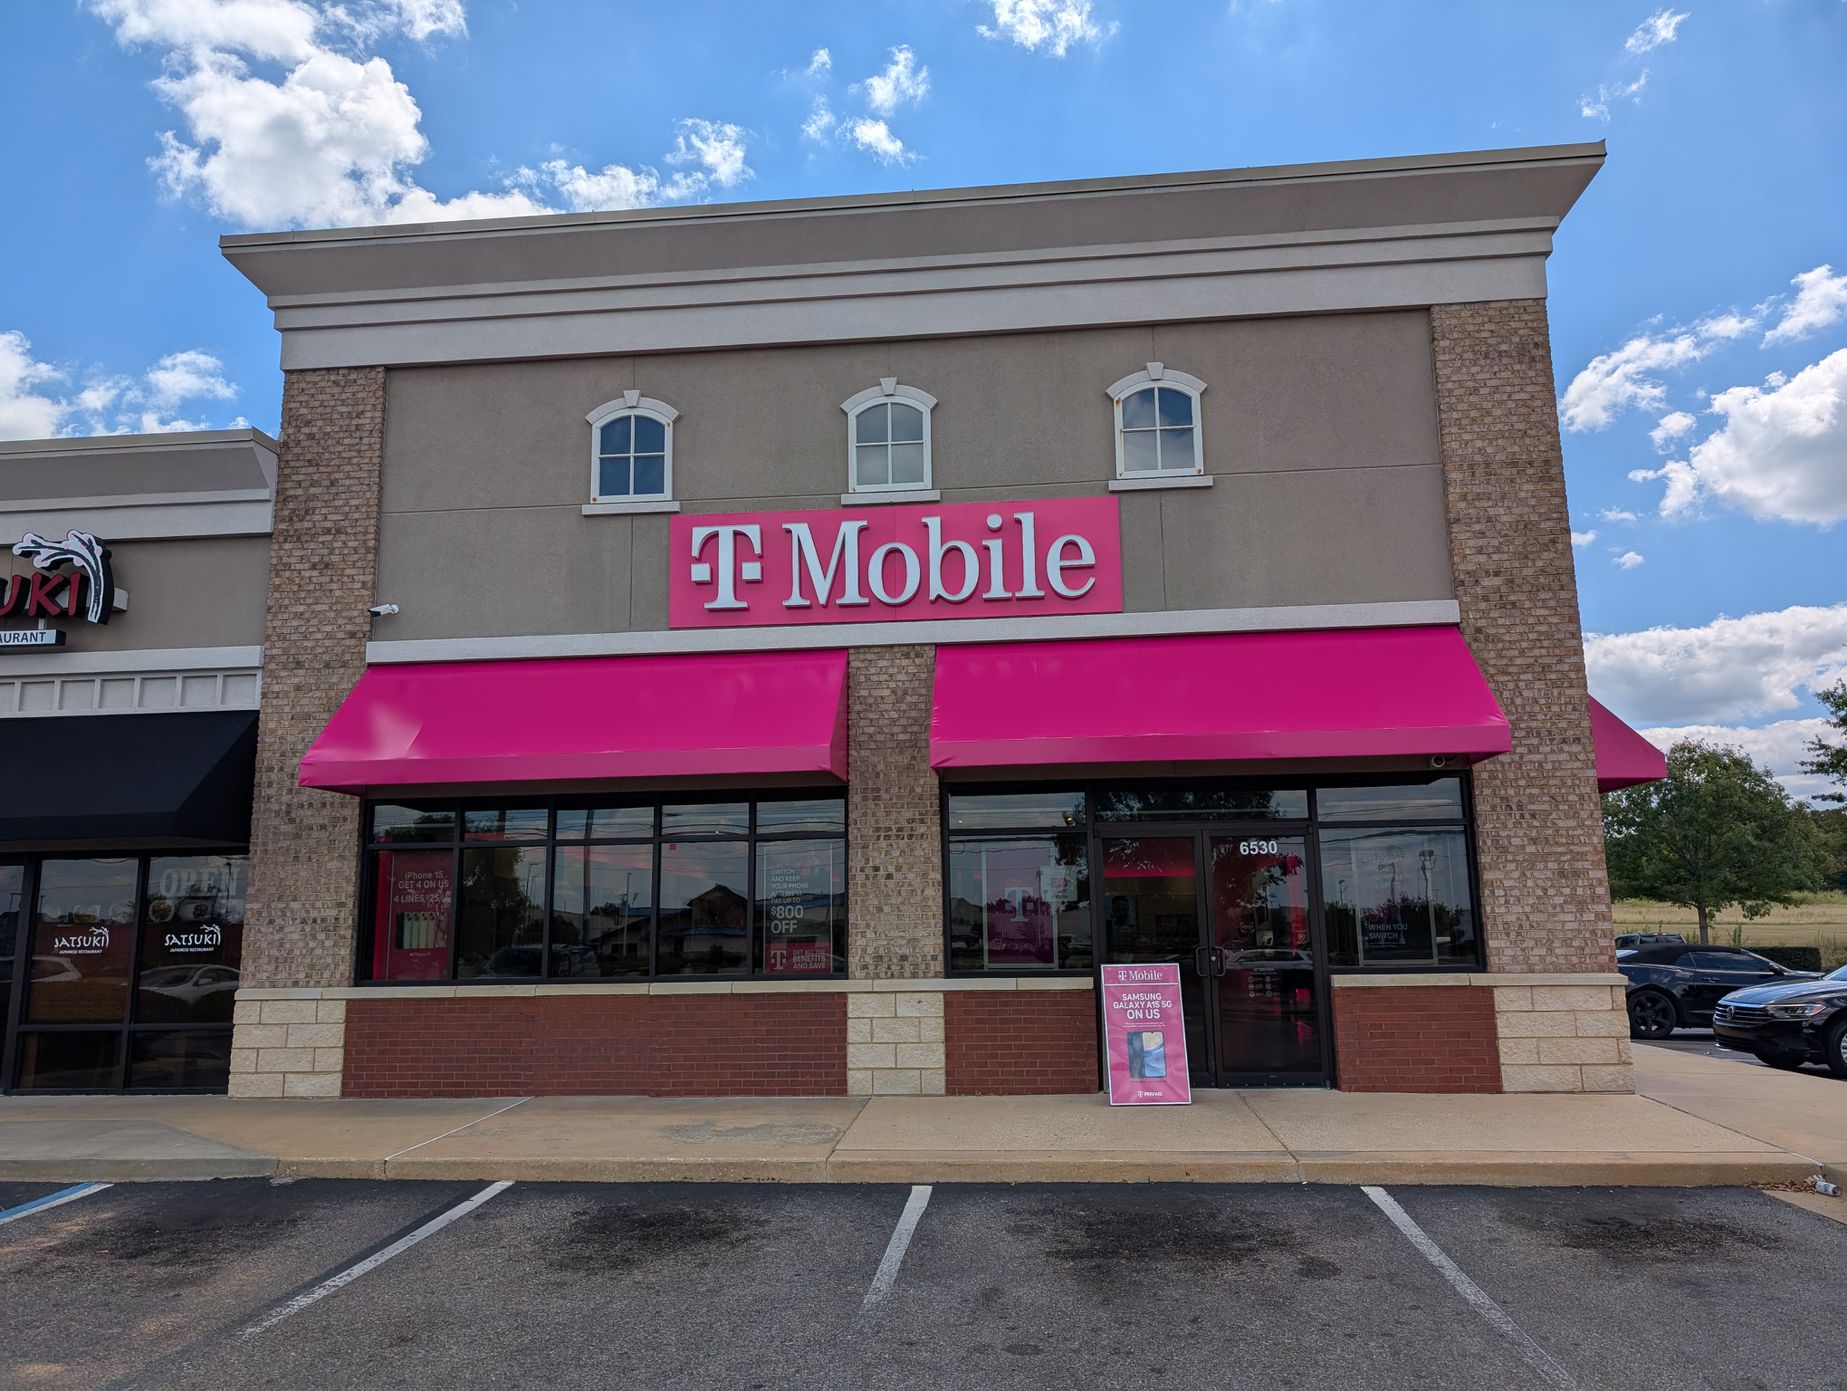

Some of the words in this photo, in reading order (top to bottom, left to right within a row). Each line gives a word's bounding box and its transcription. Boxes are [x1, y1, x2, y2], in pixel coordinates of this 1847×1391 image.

[782, 512, 1097, 607] Mobile
[1240, 840, 1278, 855] 6530
[404, 871, 432, 879] iPhone
[160, 867, 240, 898] OPEN
[398, 880, 415, 889] GET
[416, 880, 422, 888] 4
[423, 880, 436, 888] ON
[438, 880, 449, 888] US
[770, 905, 804, 919] $800
[771, 920, 798, 934] OFF
[1368, 923, 1392, 931] WHEN
[54, 935, 105, 948] SATSUKI
[164, 933, 217, 946] SATSUKI
[1368, 932, 1398, 940] SWITCH
[1128, 970, 1163, 981] Mobile
[1122, 992, 1162, 1001] SAMSUNG
[1113, 1001, 1145, 1009] GALAXY
[1161, 1000, 1173, 1008] 5G
[1126, 1009, 1143, 1019] ON
[1145, 1008, 1161, 1019] US
